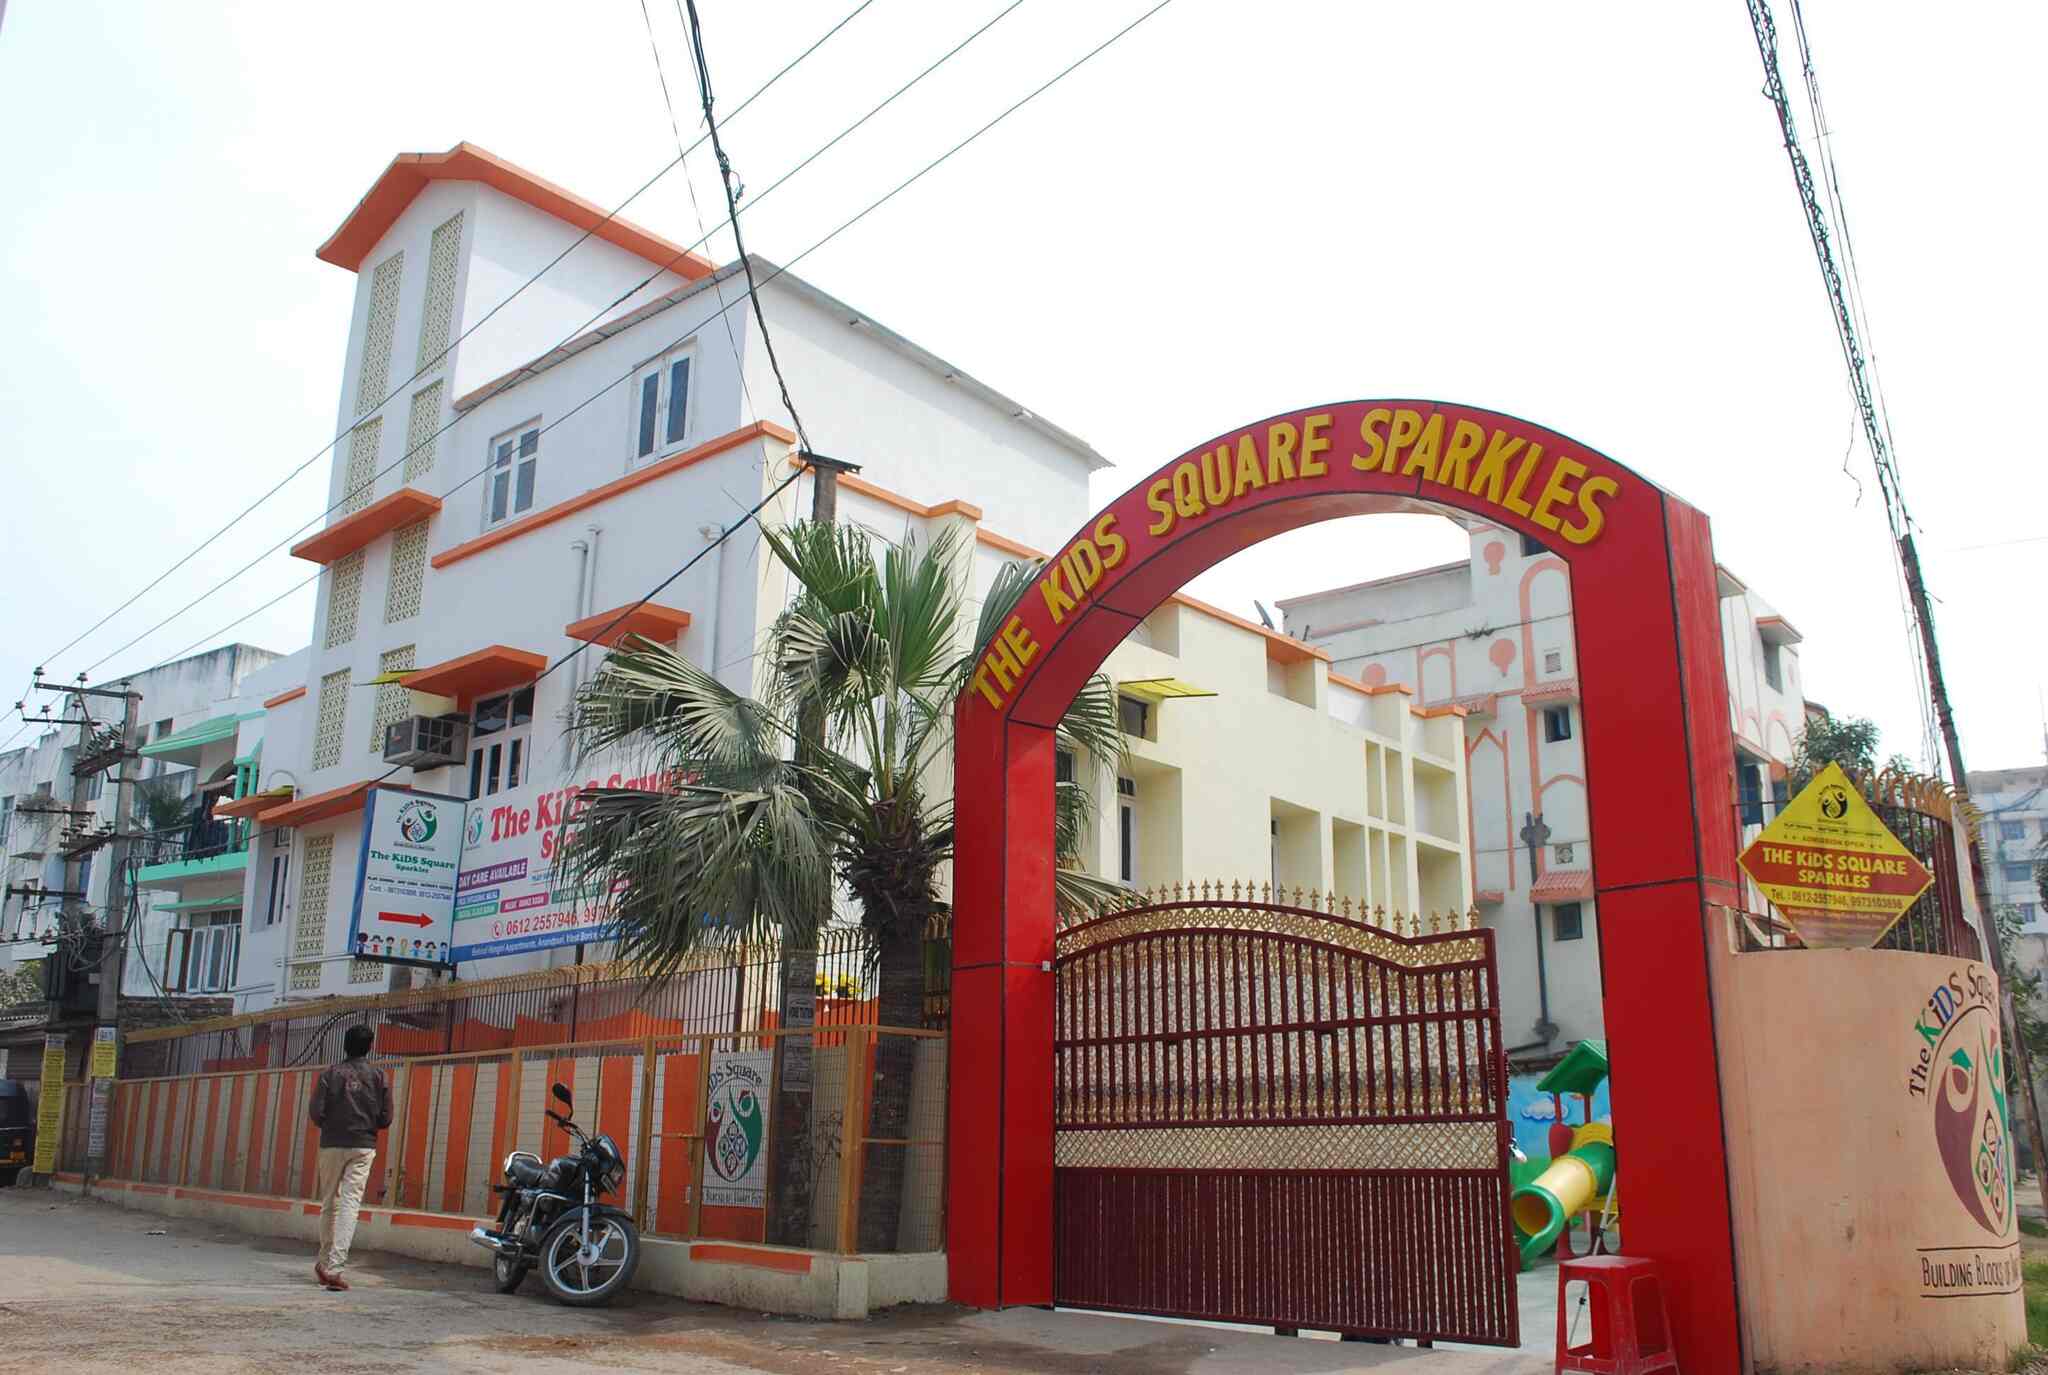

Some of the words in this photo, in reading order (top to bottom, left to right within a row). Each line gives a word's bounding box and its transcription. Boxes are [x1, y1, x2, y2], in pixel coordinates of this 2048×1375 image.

[969, 617, 1040, 709] THE
[1040, 514, 1127, 624] KIDS
[1147, 413, 1333, 537] SQUARE
[1352, 408, 1619, 545] SPARKLES
[490, 805, 530, 842] The
[371, 849, 391, 860] The
[420, 856, 455, 870] Square
[396, 864, 429, 874] Sparkles
[1763, 847, 1793, 865] THE
[1837, 856, 1907, 876] SQUARE
[471, 869, 490, 886] CARE
[489, 861, 527, 883] AVAILABLE
[1799, 869, 1871, 889] SPARKLES
[506, 919, 530, 937] 0612
[725, 1059, 762, 1087] Square
[1909, 1047, 1931, 1097] The
